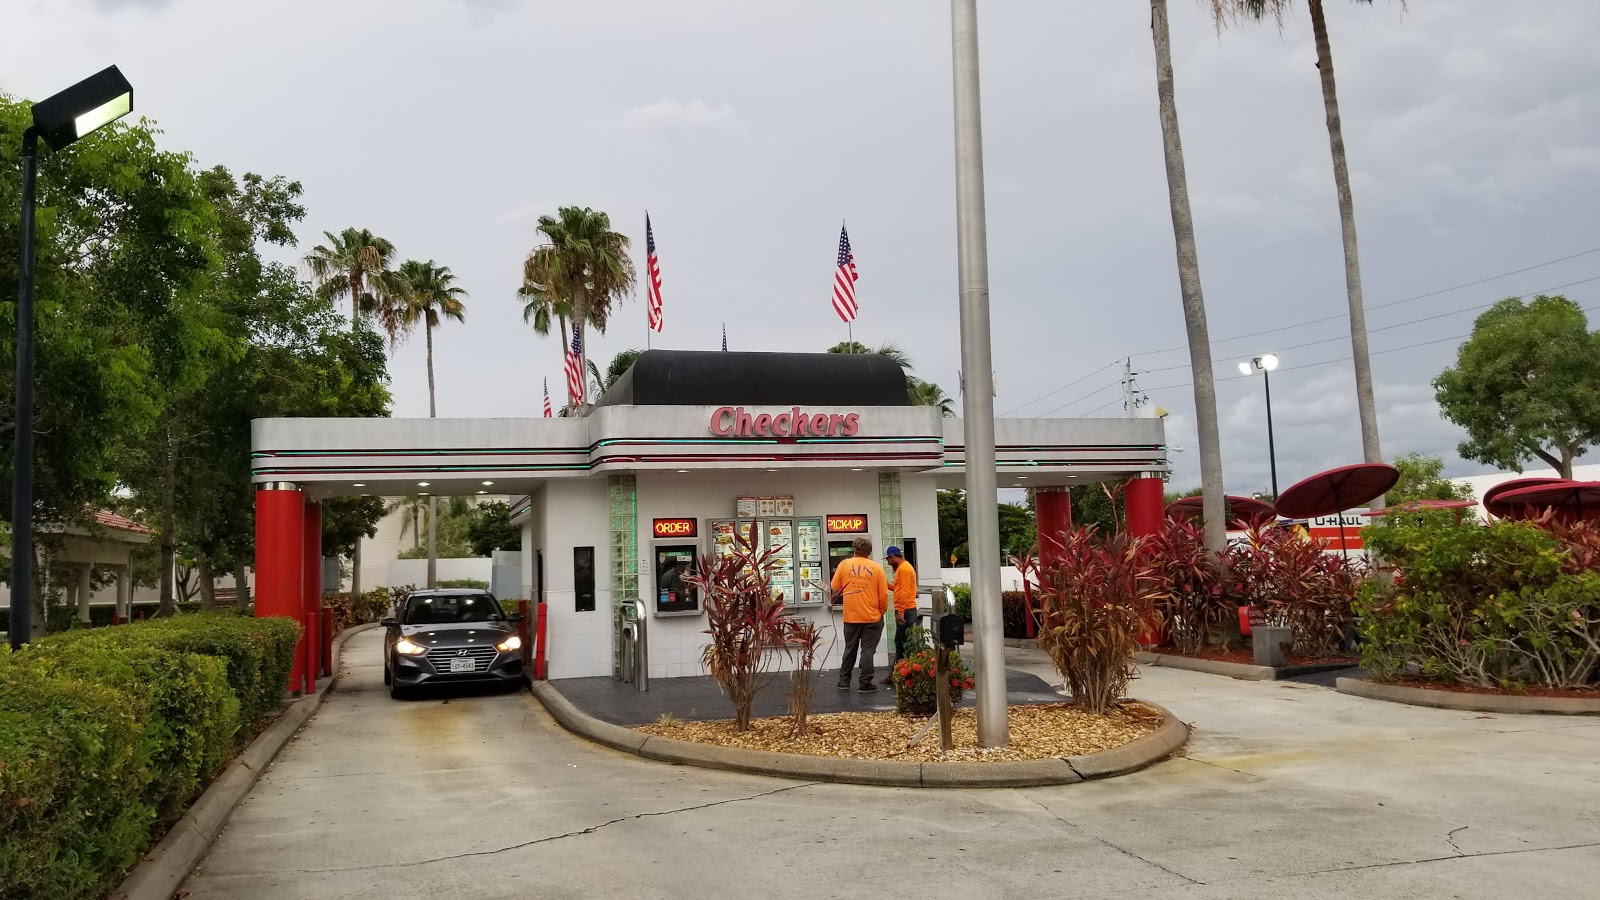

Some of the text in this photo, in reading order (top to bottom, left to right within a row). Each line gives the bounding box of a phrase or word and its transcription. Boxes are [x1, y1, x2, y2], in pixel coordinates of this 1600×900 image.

[709, 407, 860, 436] Checkers
[828, 519, 863, 530] PICK-UP
[1315, 517, 1363, 526] U-HAUL
[655, 522, 690, 533] ORDER
